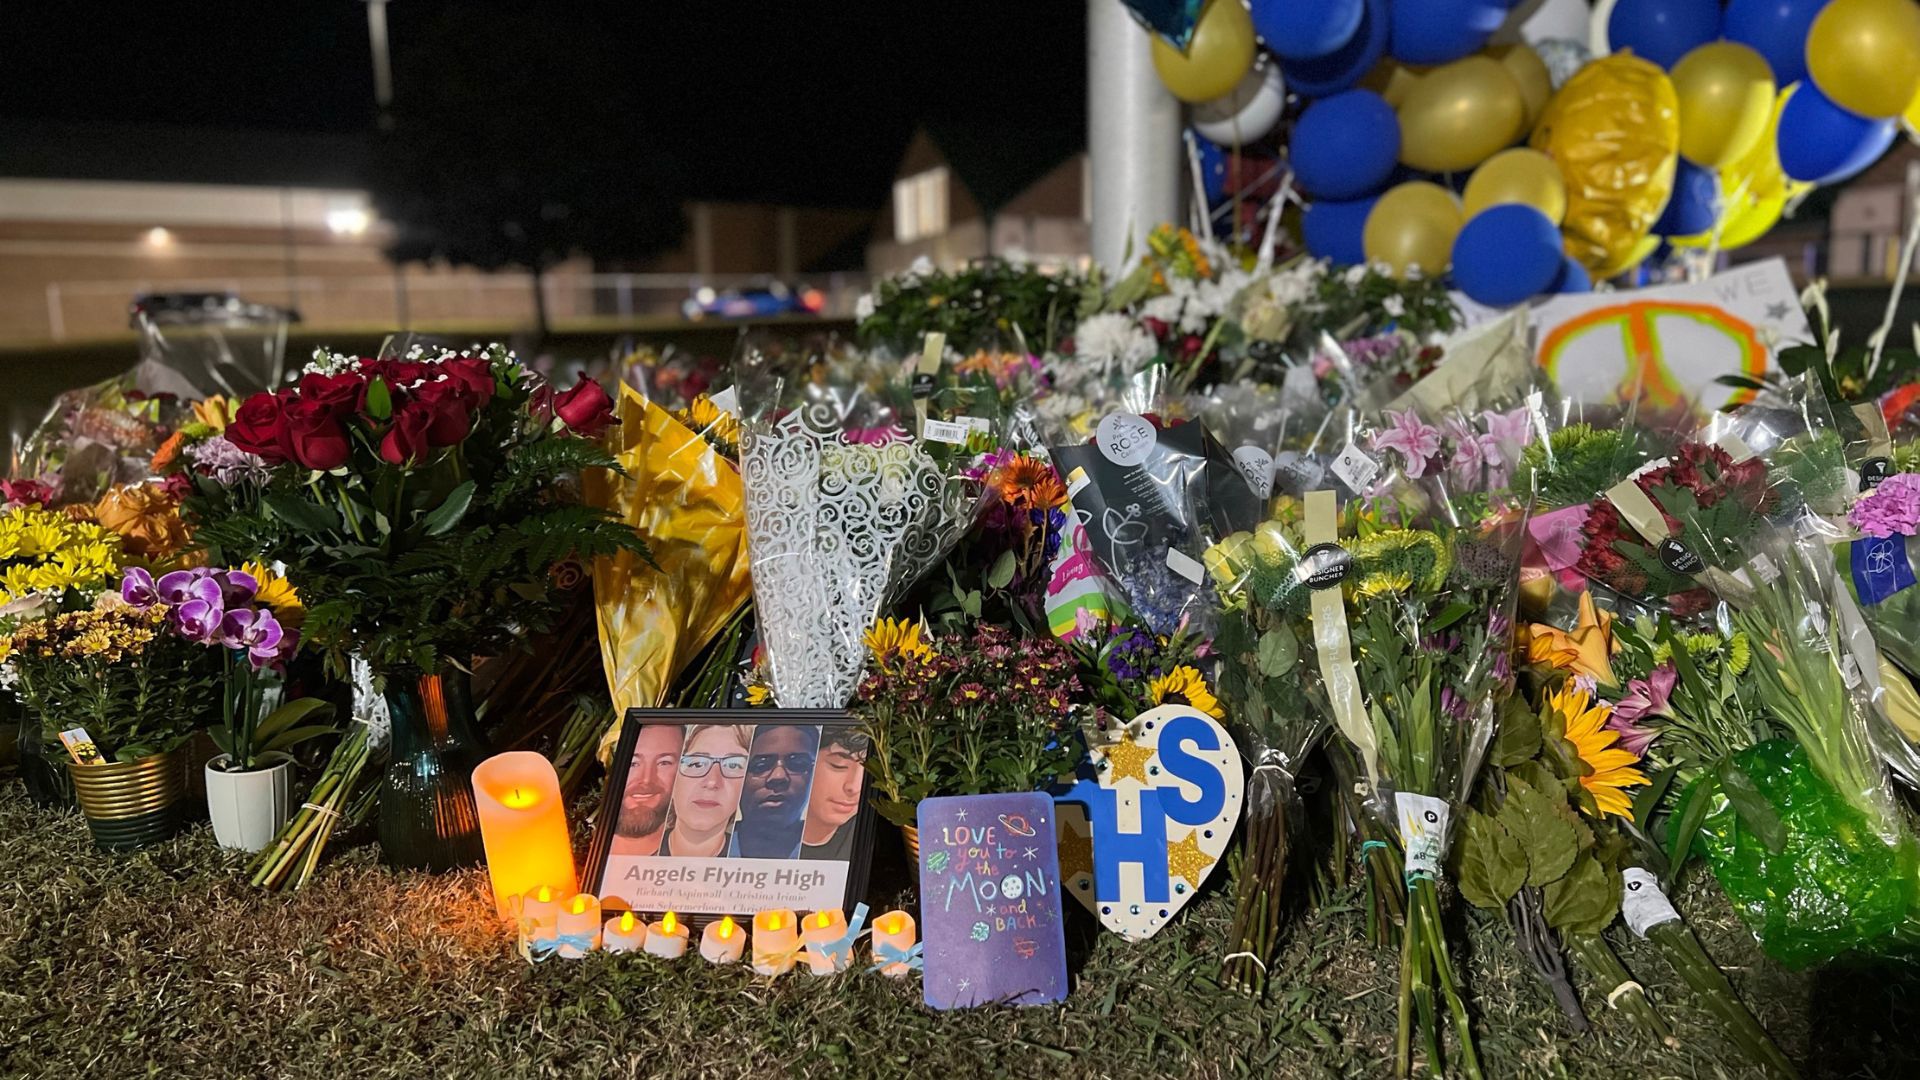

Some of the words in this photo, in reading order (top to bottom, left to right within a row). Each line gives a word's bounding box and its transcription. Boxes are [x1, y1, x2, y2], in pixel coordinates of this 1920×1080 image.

[1713, 270, 1774, 302] WE
[1110, 427, 1148, 454] ROSE
[1309, 572, 1343, 583] BUNCHES
[942, 826, 996, 846] LOVE
[955, 847, 990, 872] you
[996, 843, 1017, 859] to
[624, 865, 696, 886] Angels
[703, 867, 768, 888] Flying
[774, 869, 825, 890] High
[975, 861, 999, 875] the
[636, 887, 673, 897] Richard
[1000, 899, 1027, 915] and
